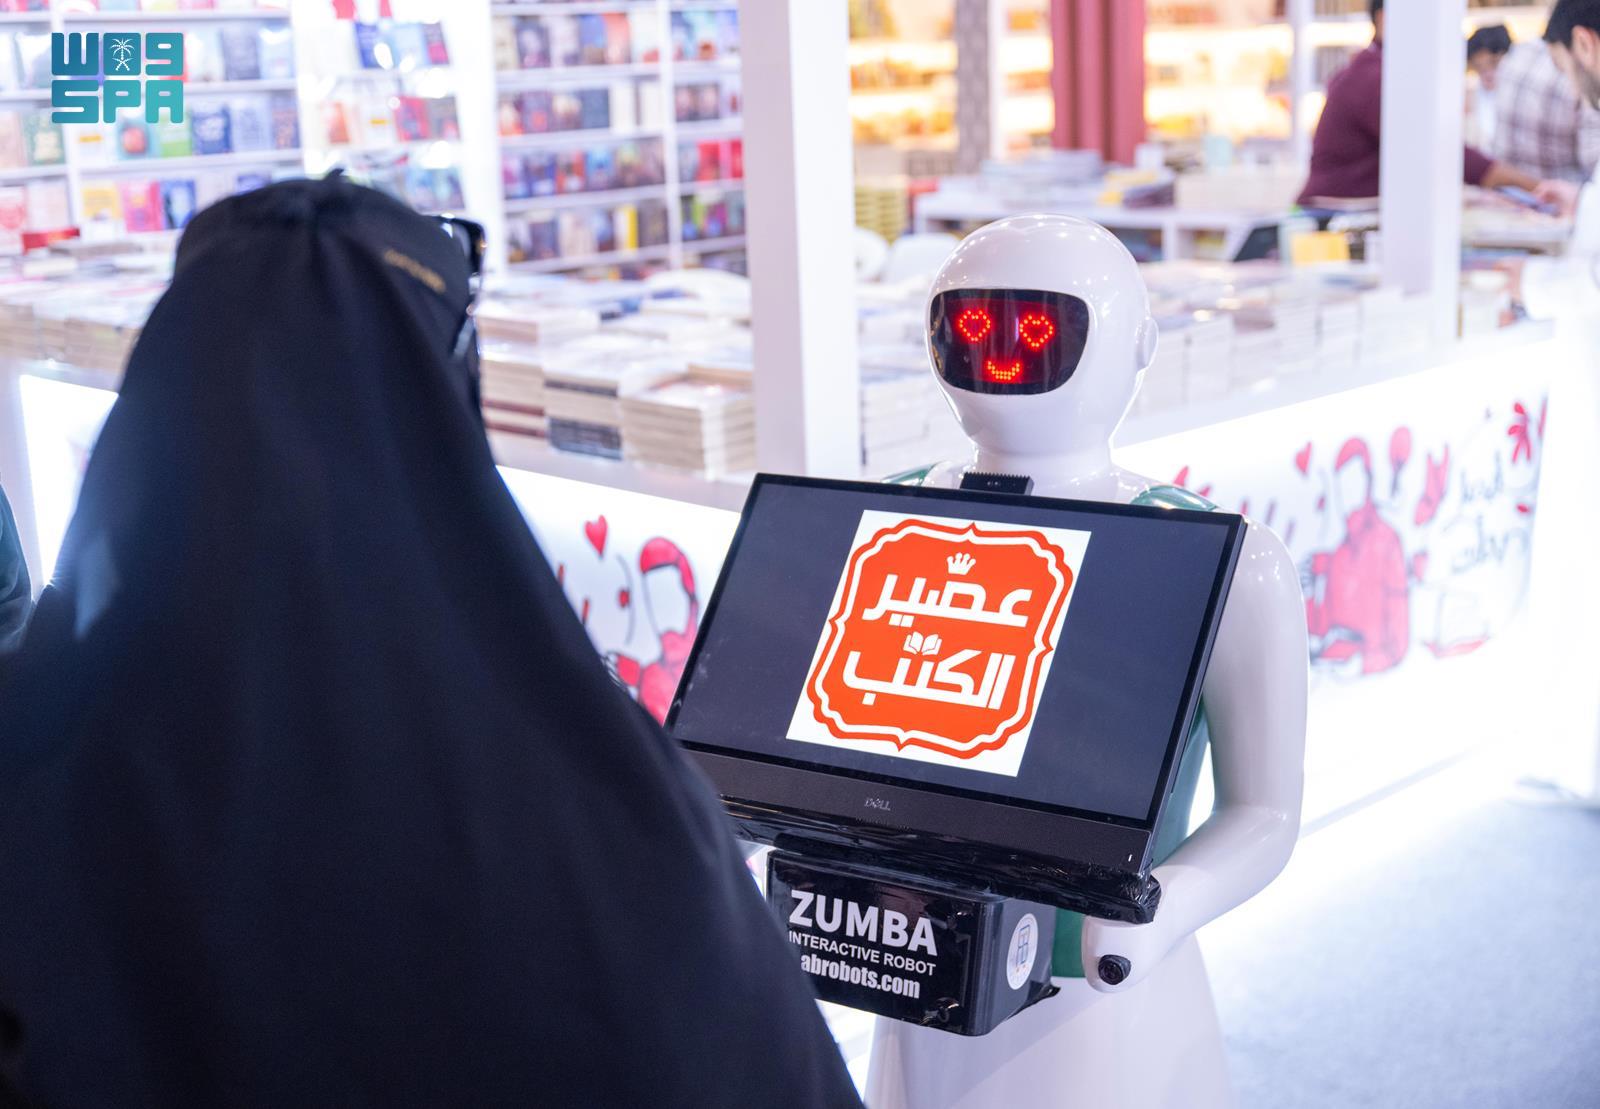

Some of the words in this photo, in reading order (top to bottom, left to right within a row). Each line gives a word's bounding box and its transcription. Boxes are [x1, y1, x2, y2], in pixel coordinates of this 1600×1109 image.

[862, 574, 1032, 628] عصير
[842, 648, 1016, 710] الكتب
[864, 798, 891, 811] DELL
[789, 889, 938, 956] ZUMBA
[788, 930, 881, 964] INTERACTIVE
[883, 952, 937, 976] ROBOT
[800, 953, 920, 999] abrobots.com
